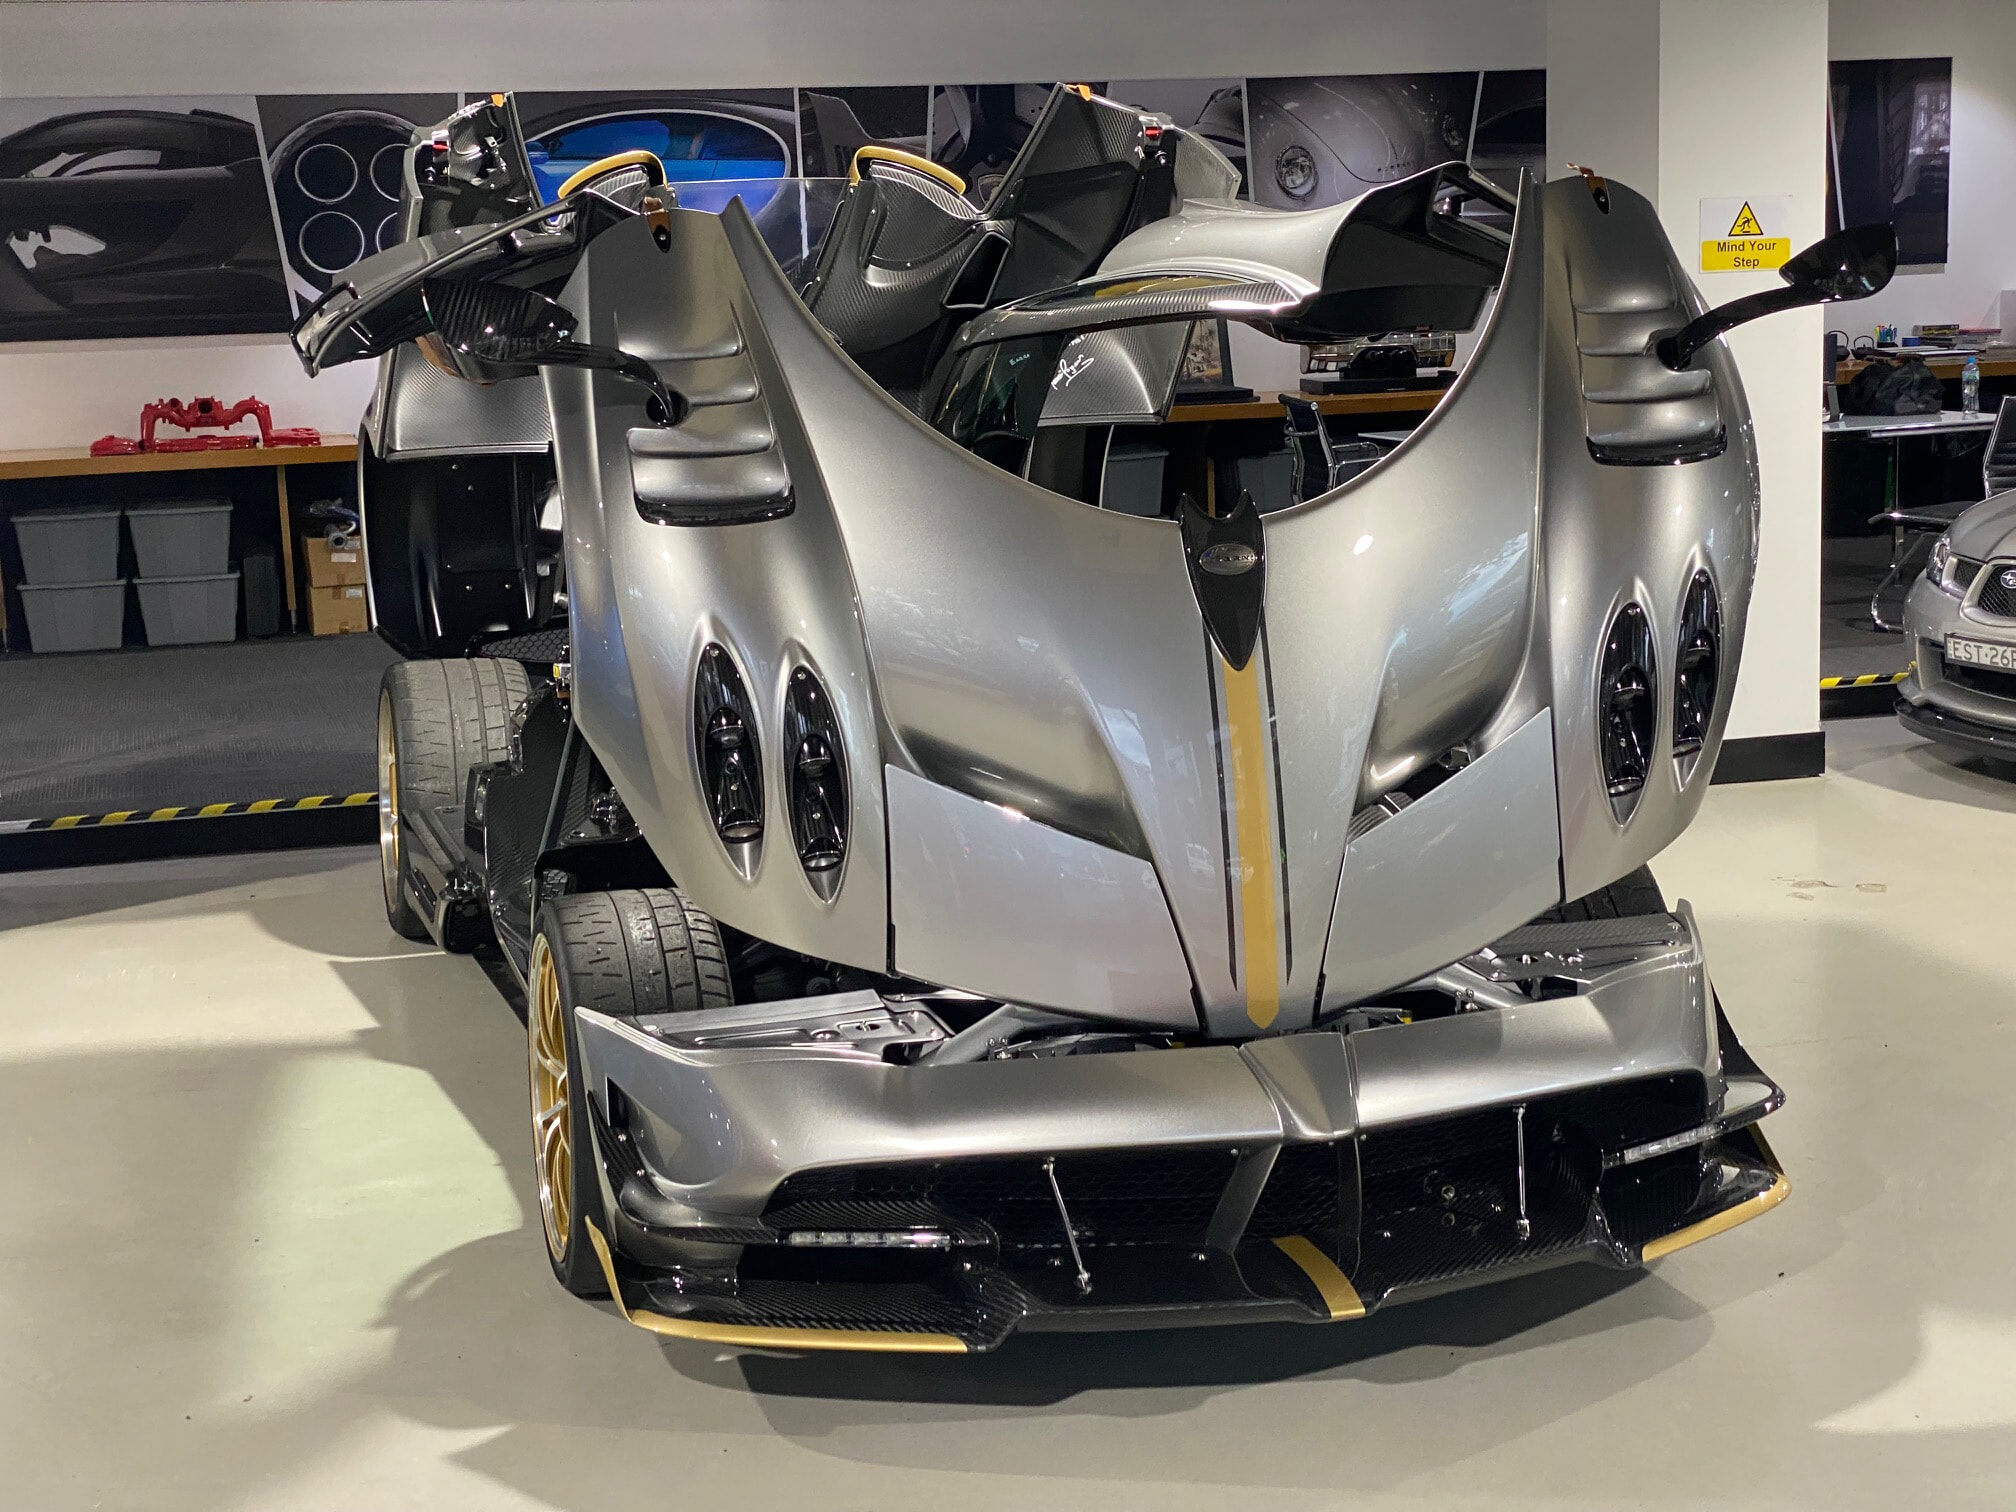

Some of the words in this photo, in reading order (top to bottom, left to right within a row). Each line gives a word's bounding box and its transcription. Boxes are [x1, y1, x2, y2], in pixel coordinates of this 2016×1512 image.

[1717, 241, 1745, 253] Mind
[1749, 240, 1777, 251] Your
[1733, 257, 1760, 269] Step
